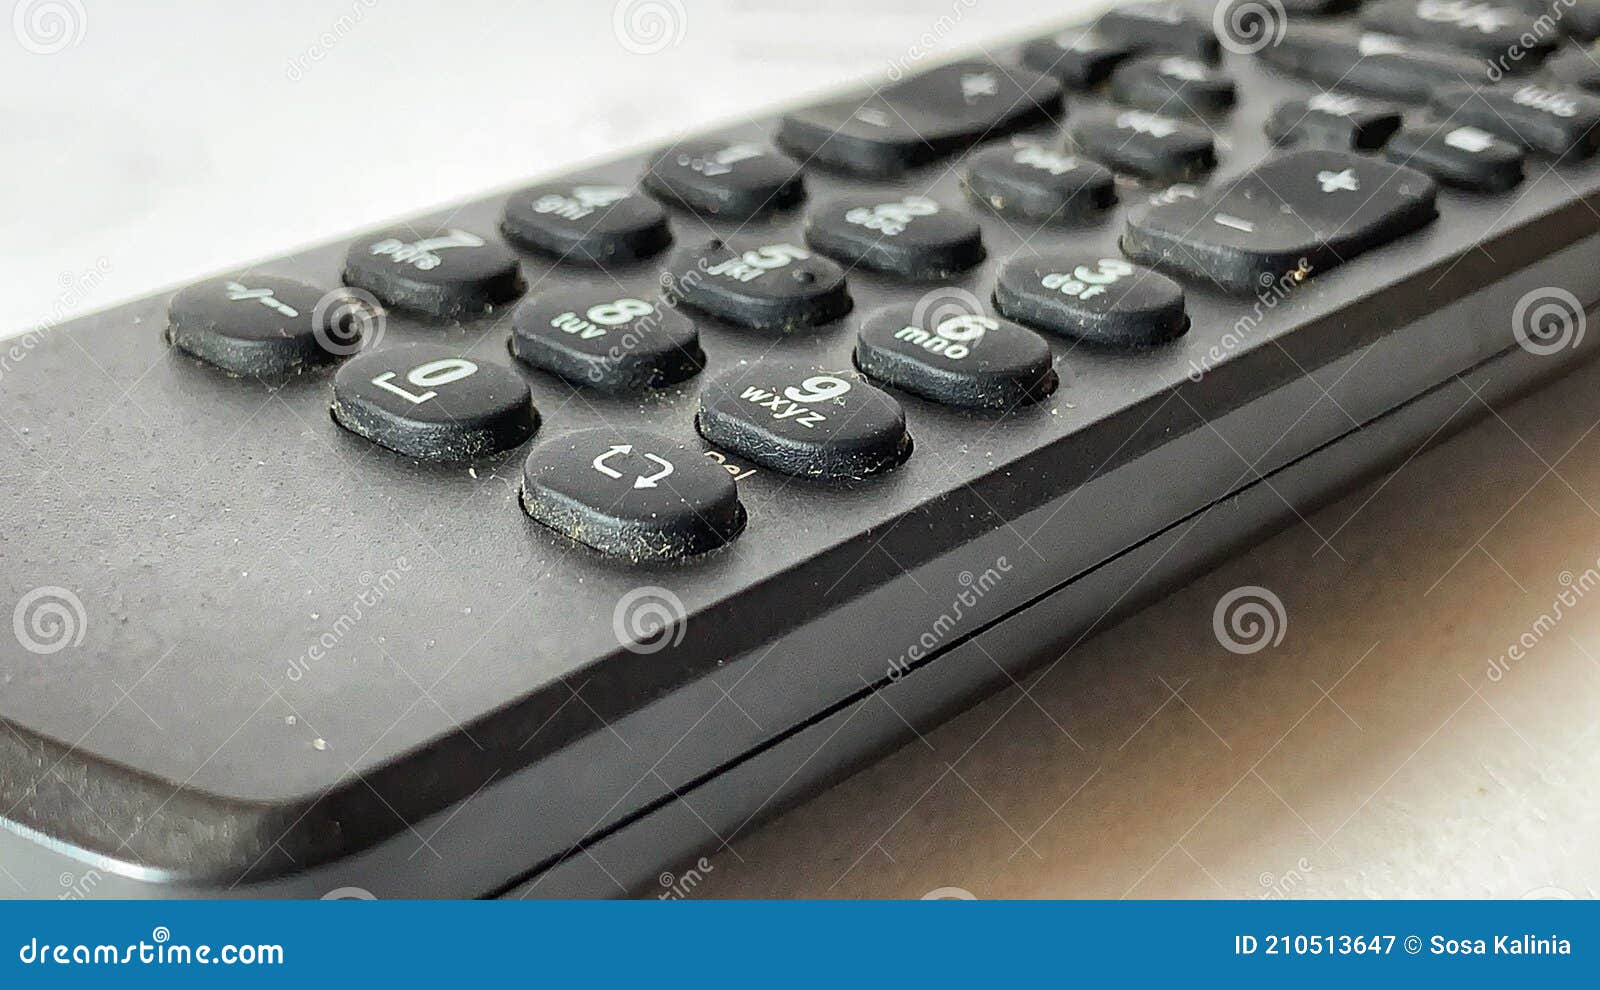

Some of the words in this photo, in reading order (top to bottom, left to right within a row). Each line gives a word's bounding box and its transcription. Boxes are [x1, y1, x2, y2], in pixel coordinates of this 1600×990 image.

[742, 243, 811, 269] 5
[1074, 258, 1134, 284] 3
[1041, 273, 1106, 300] def
[586, 298, 654, 325] 8
[550, 312, 607, 339] tuv
[936, 314, 999, 341] 6
[894, 326, 970, 360] mno
[407, 358, 479, 387] 0
[784, 376, 851, 402] 9
[740, 386, 826, 428] wxyz
